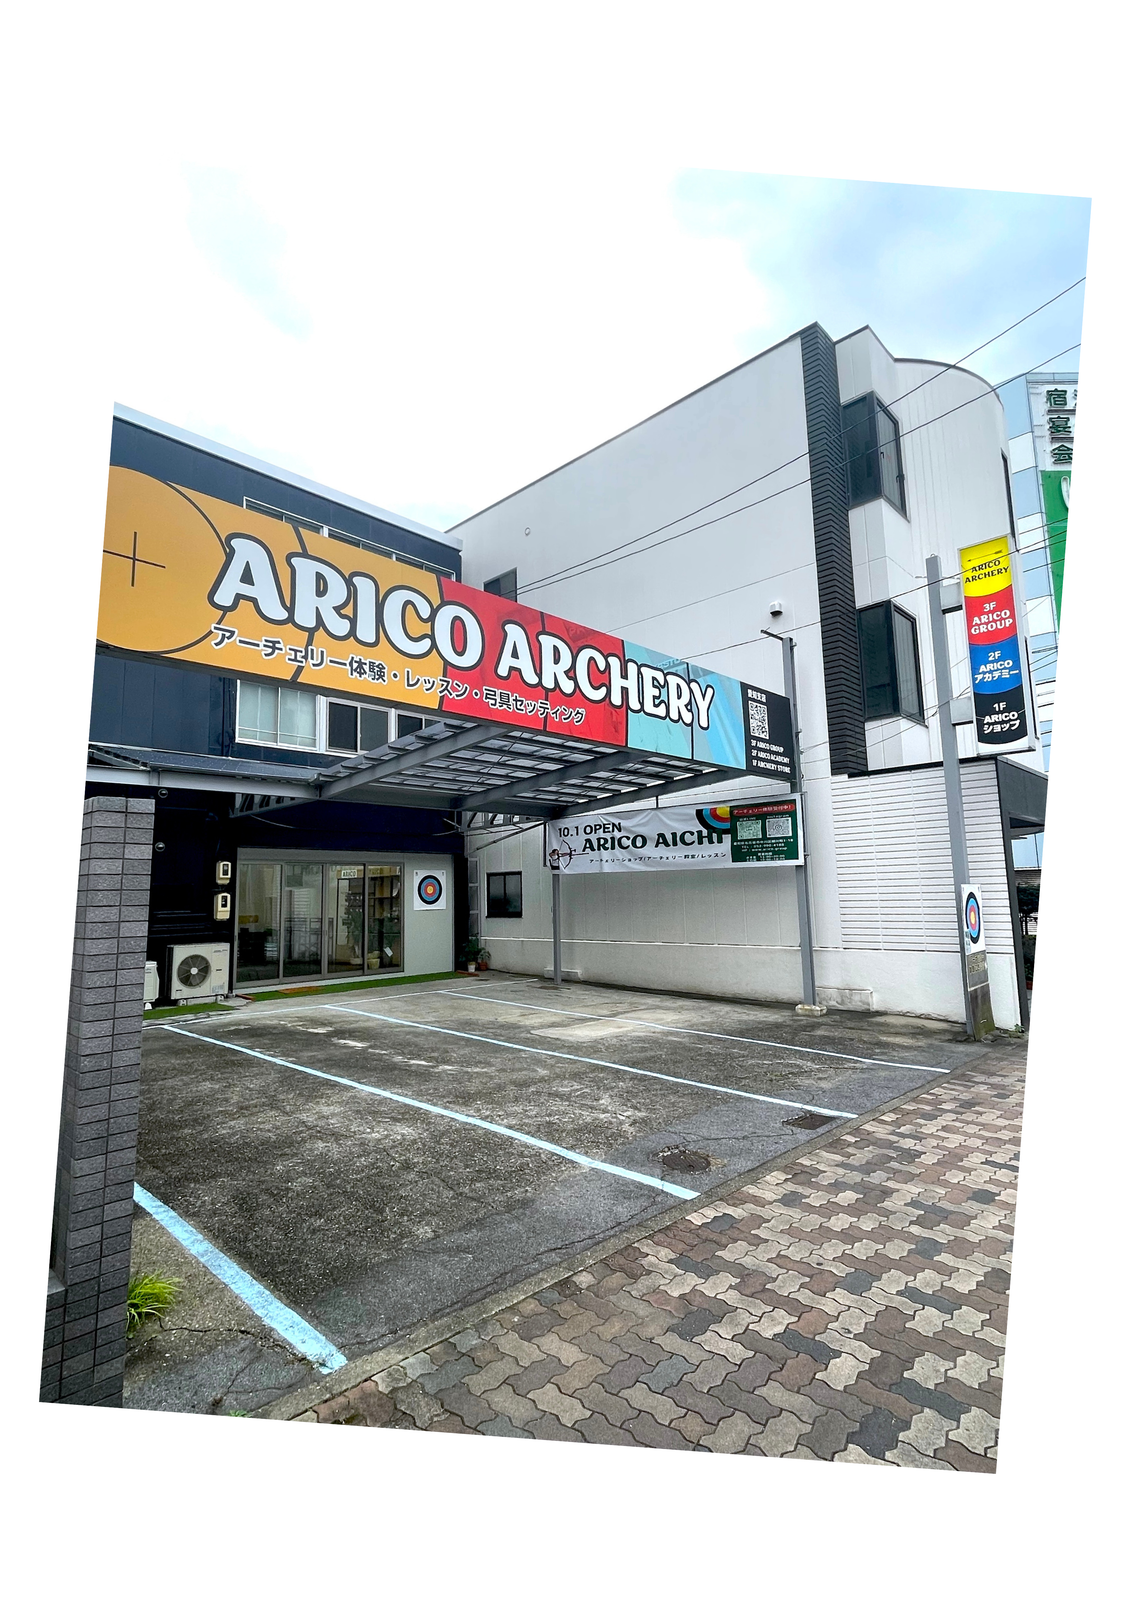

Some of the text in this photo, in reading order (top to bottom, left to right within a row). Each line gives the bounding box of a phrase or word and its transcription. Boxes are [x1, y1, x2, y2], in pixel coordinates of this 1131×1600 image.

[971, 560, 1001, 573] ARICO
[964, 566, 1010, 584] ARCHERY
[983, 602, 997, 612] 3F
[972, 609, 1010, 625] ARICO
[208, 533, 714, 730] ARICO ARCHERY
[971, 619, 1013, 635] GROUP
[988, 651, 1001, 661] 2F
[979, 660, 1013, 673] ARICO
[211, 625, 586, 724] アーチェリー体験・レッスン・弓具セッティング
[974, 669, 1019, 684] アカデミー
[993, 702, 1007, 712] 1F
[983, 711, 1018, 724] ARICO
[983, 720, 1020, 734] ショップ
[558, 822, 622, 838] 10.1 OPEN
[582, 833, 648, 852] ARICO
[654, 829, 724, 848] AICHI
